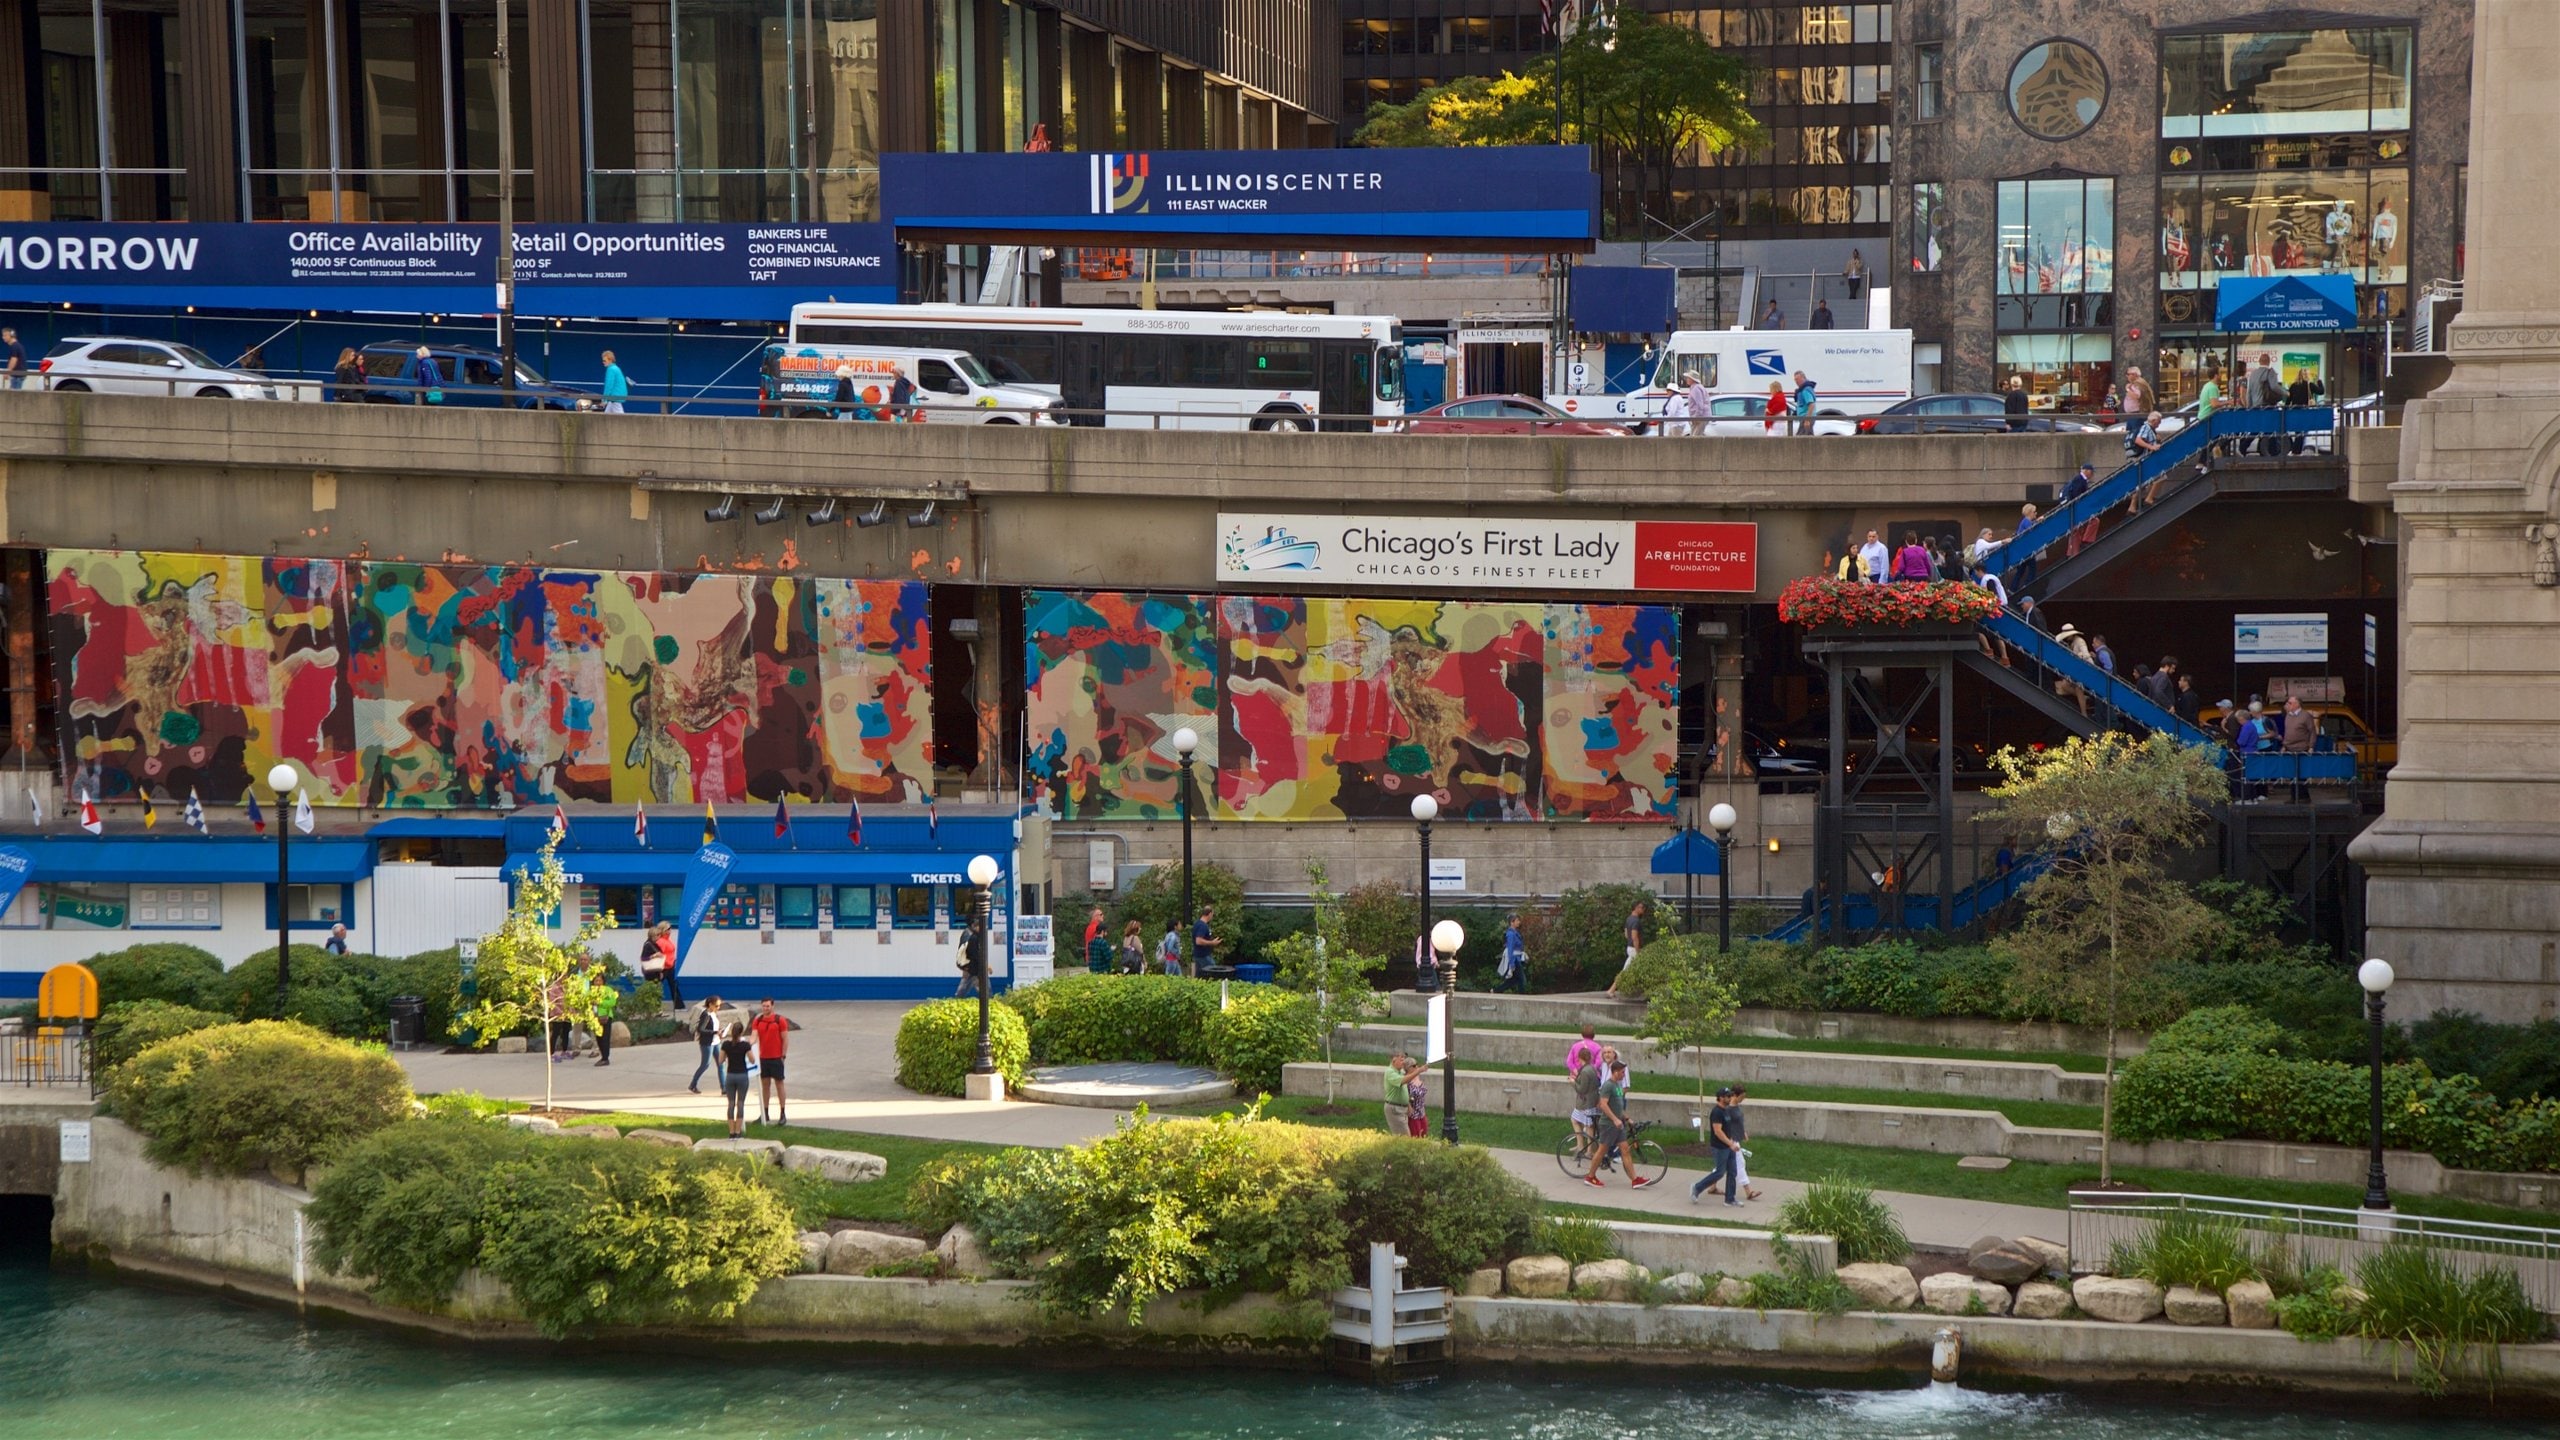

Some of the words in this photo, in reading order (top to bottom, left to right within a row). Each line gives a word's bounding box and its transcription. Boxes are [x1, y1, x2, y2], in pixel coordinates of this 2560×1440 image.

[2268, 153, 2301, 162] STORE
[1166, 173, 1382, 192] ILLINOISCENTER
[1167, 200, 1182, 210] 111
[1184, 200, 1215, 210] EAST
[1218, 200, 1268, 210] WACKER
[748, 229, 802, 240] BANKERS
[804, 228, 828, 239] LIFE
[288, 232, 356, 252] Office
[361, 232, 482, 256] Availability
[573, 232, 725, 256] Opportunities
[748, 244, 774, 254] CNO
[777, 244, 838, 254] FINANCIAL
[290, 258, 332, 268] 140,000
[333, 258, 347, 267] SF
[349, 258, 406, 268] Continuous
[408, 258, 436, 268] Block
[538, 258, 552, 268] SF
[748, 257, 811, 268] COMBINED
[814, 256, 880, 267] INSURANCE
[749, 271, 778, 280] TAFT
[1127, 320, 1190, 330] 888-305-8700
[1221, 322, 1320, 334] www.ariescharter.com
[2240, 320, 2278, 330] TICKETS
[2280, 319, 2340, 328] DOWNSTAIRS
[780, 356, 820, 372] MARINE
[1342, 528, 1473, 561] Chicago's
[1484, 531, 1543, 556] First
[1554, 532, 1620, 565] Lady
[1644, 551, 1747, 562] ARCHITECTURE
[1356, 564, 1460, 576] CHICAGO'S
[1472, 566, 1536, 577] FINEST
[1548, 568, 1602, 578] FLEET
[704, 848, 730, 862] TICKET
[532, 873, 584, 883] TIETS
[911, 874, 962, 884] TICKETS
